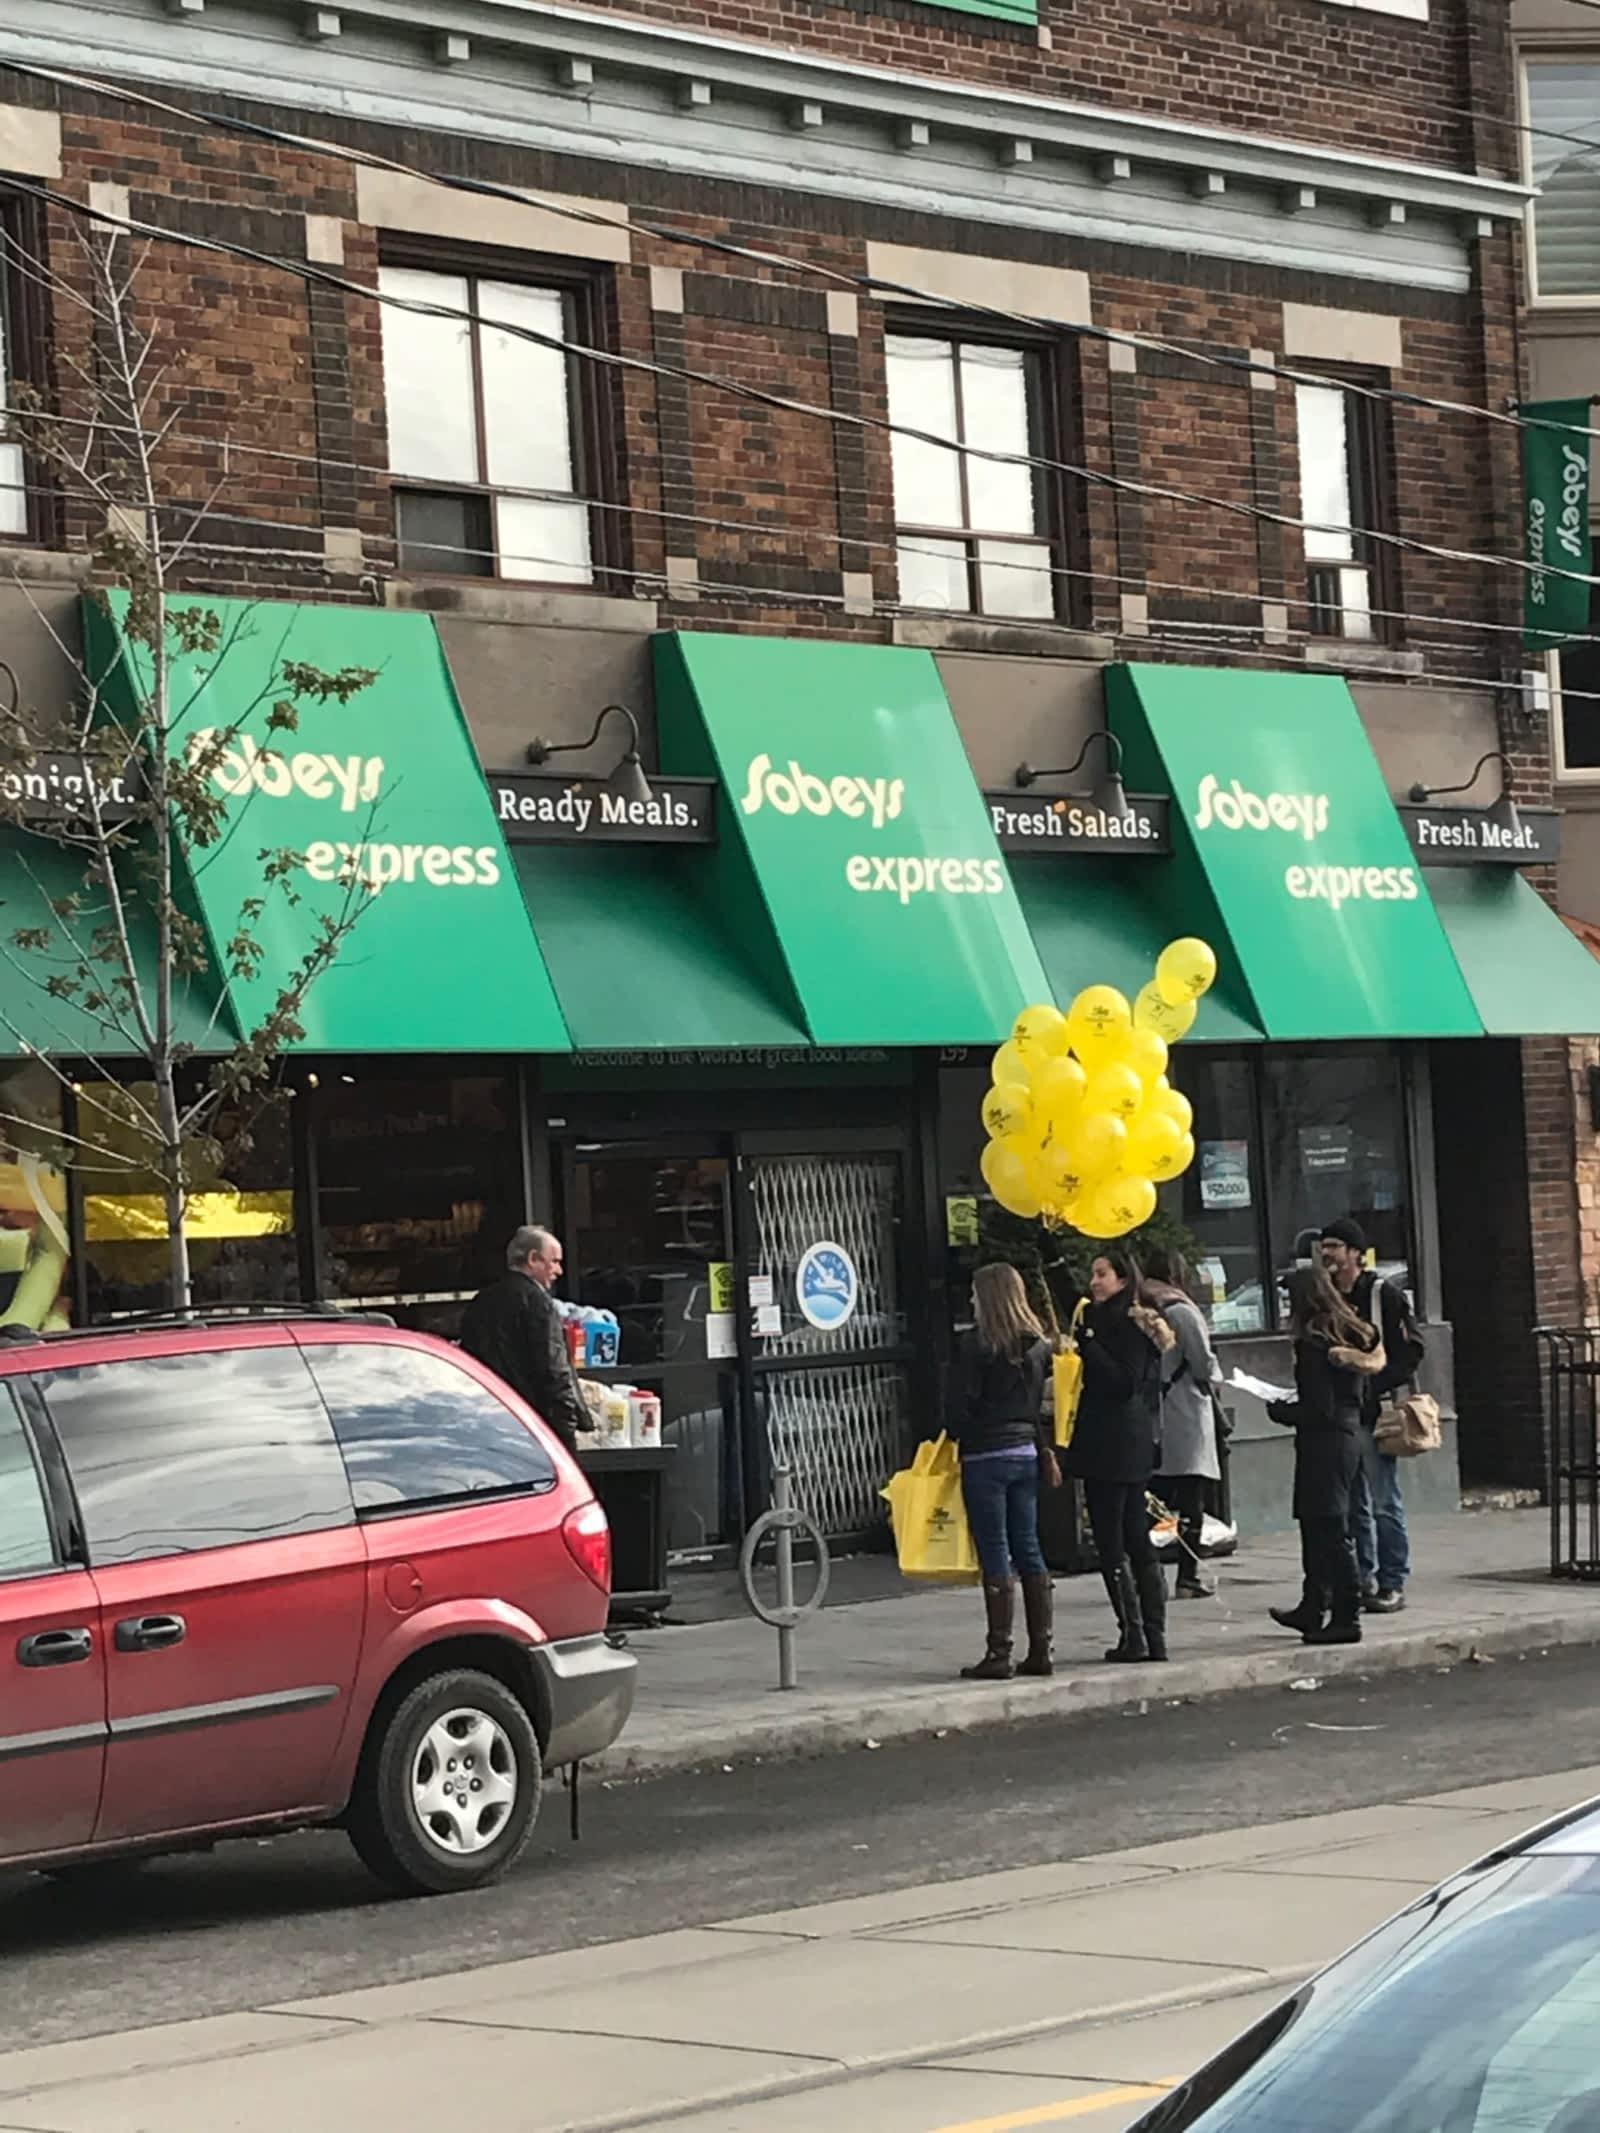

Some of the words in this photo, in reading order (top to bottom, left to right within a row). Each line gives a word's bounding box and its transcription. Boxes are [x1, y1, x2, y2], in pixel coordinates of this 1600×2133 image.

[1556, 445, 1588, 557] Sobeys
[1527, 498, 1546, 605] exprss
[498, 789, 593, 832] Ready
[599, 792, 699, 828] Meals.
[741, 753, 905, 828] Sobeys
[1195, 774, 1329, 841] Sobeys
[991, 805, 1064, 836] Fresh
[1068, 808, 1160, 839] Salads.
[1417, 818, 1477, 848] Fresh
[1481, 821, 1541, 850] Meat.
[304, 840, 500, 896] express
[845, 855, 1004, 904] express
[1285, 864, 1418, 910] express
